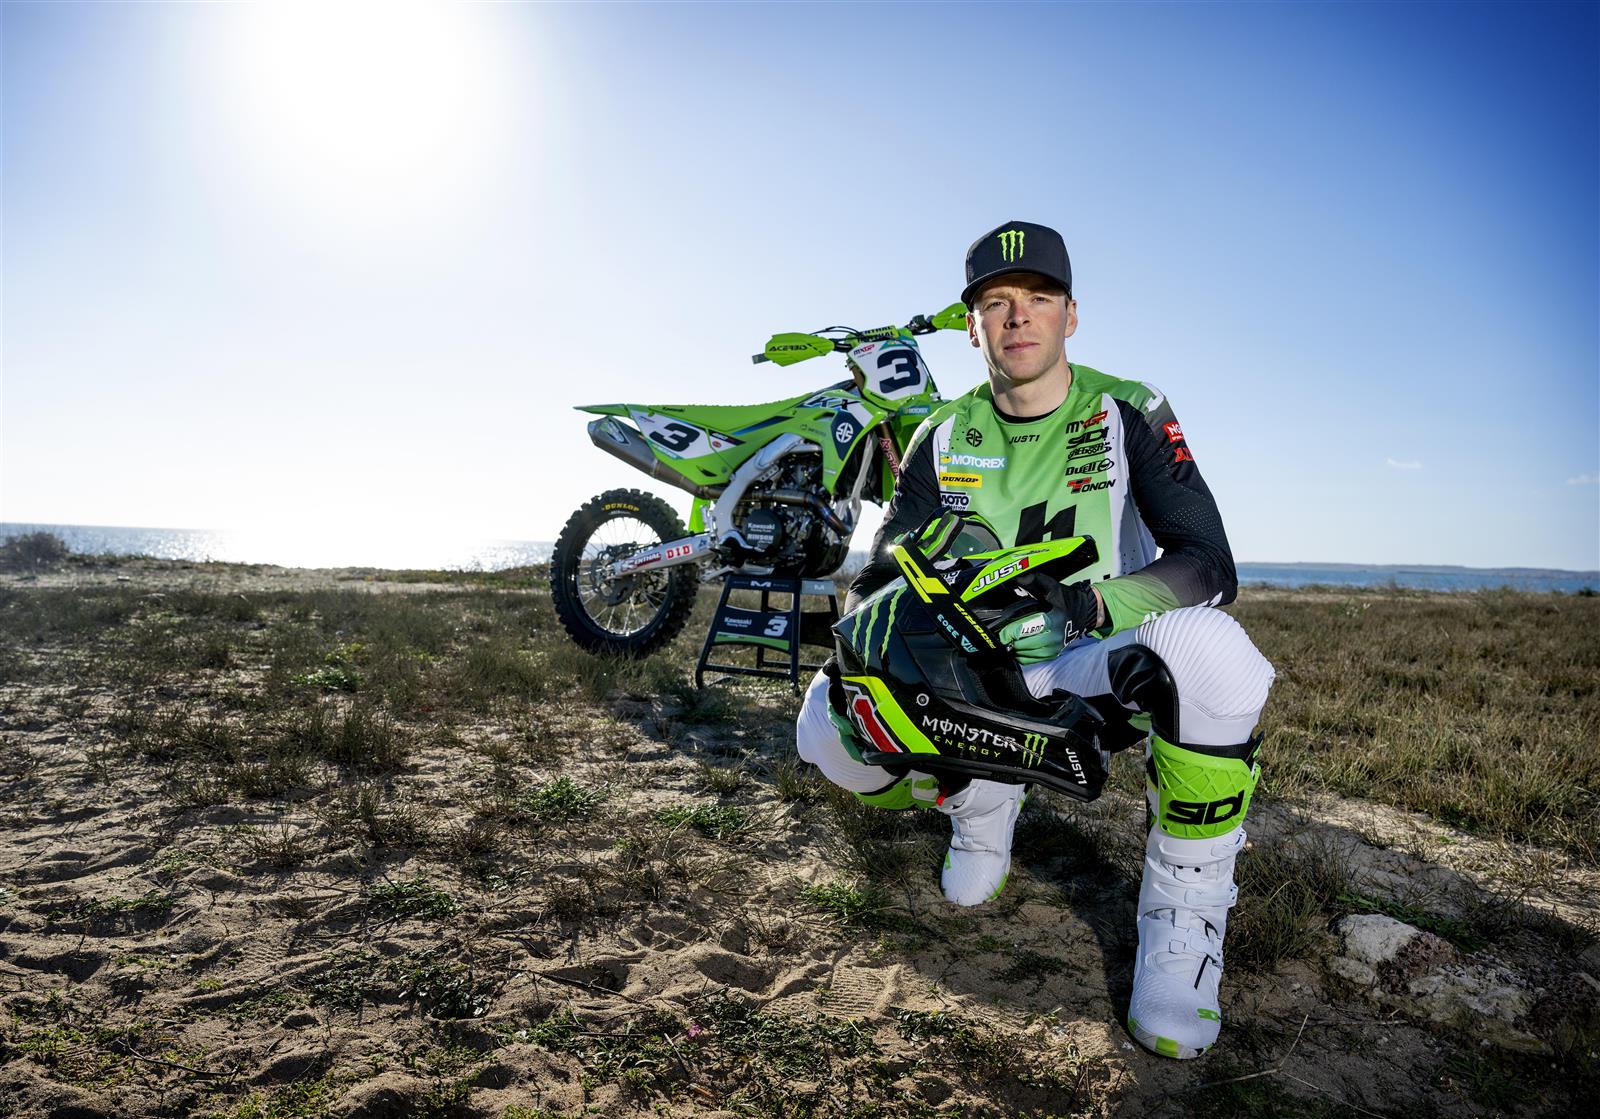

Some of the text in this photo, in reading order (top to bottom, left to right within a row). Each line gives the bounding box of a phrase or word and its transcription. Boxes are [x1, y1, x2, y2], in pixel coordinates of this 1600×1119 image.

[877, 349, 920, 393] 3
[649, 422, 700, 452] 3
[1008, 434, 1040, 445] JUST1
[952, 454, 1006, 469] MOTOREX
[941, 476, 979, 484] DUNLOP
[604, 502, 640, 511] DUNLOP
[972, 556, 1029, 592] JUST1
[764, 618, 788, 637] 3
[954, 603, 996, 648] PROGRIP
[922, 715, 1017, 752] MONSTER
[934, 735, 1001, 757] ENERGY
[1065, 747, 1088, 785] JUST1
